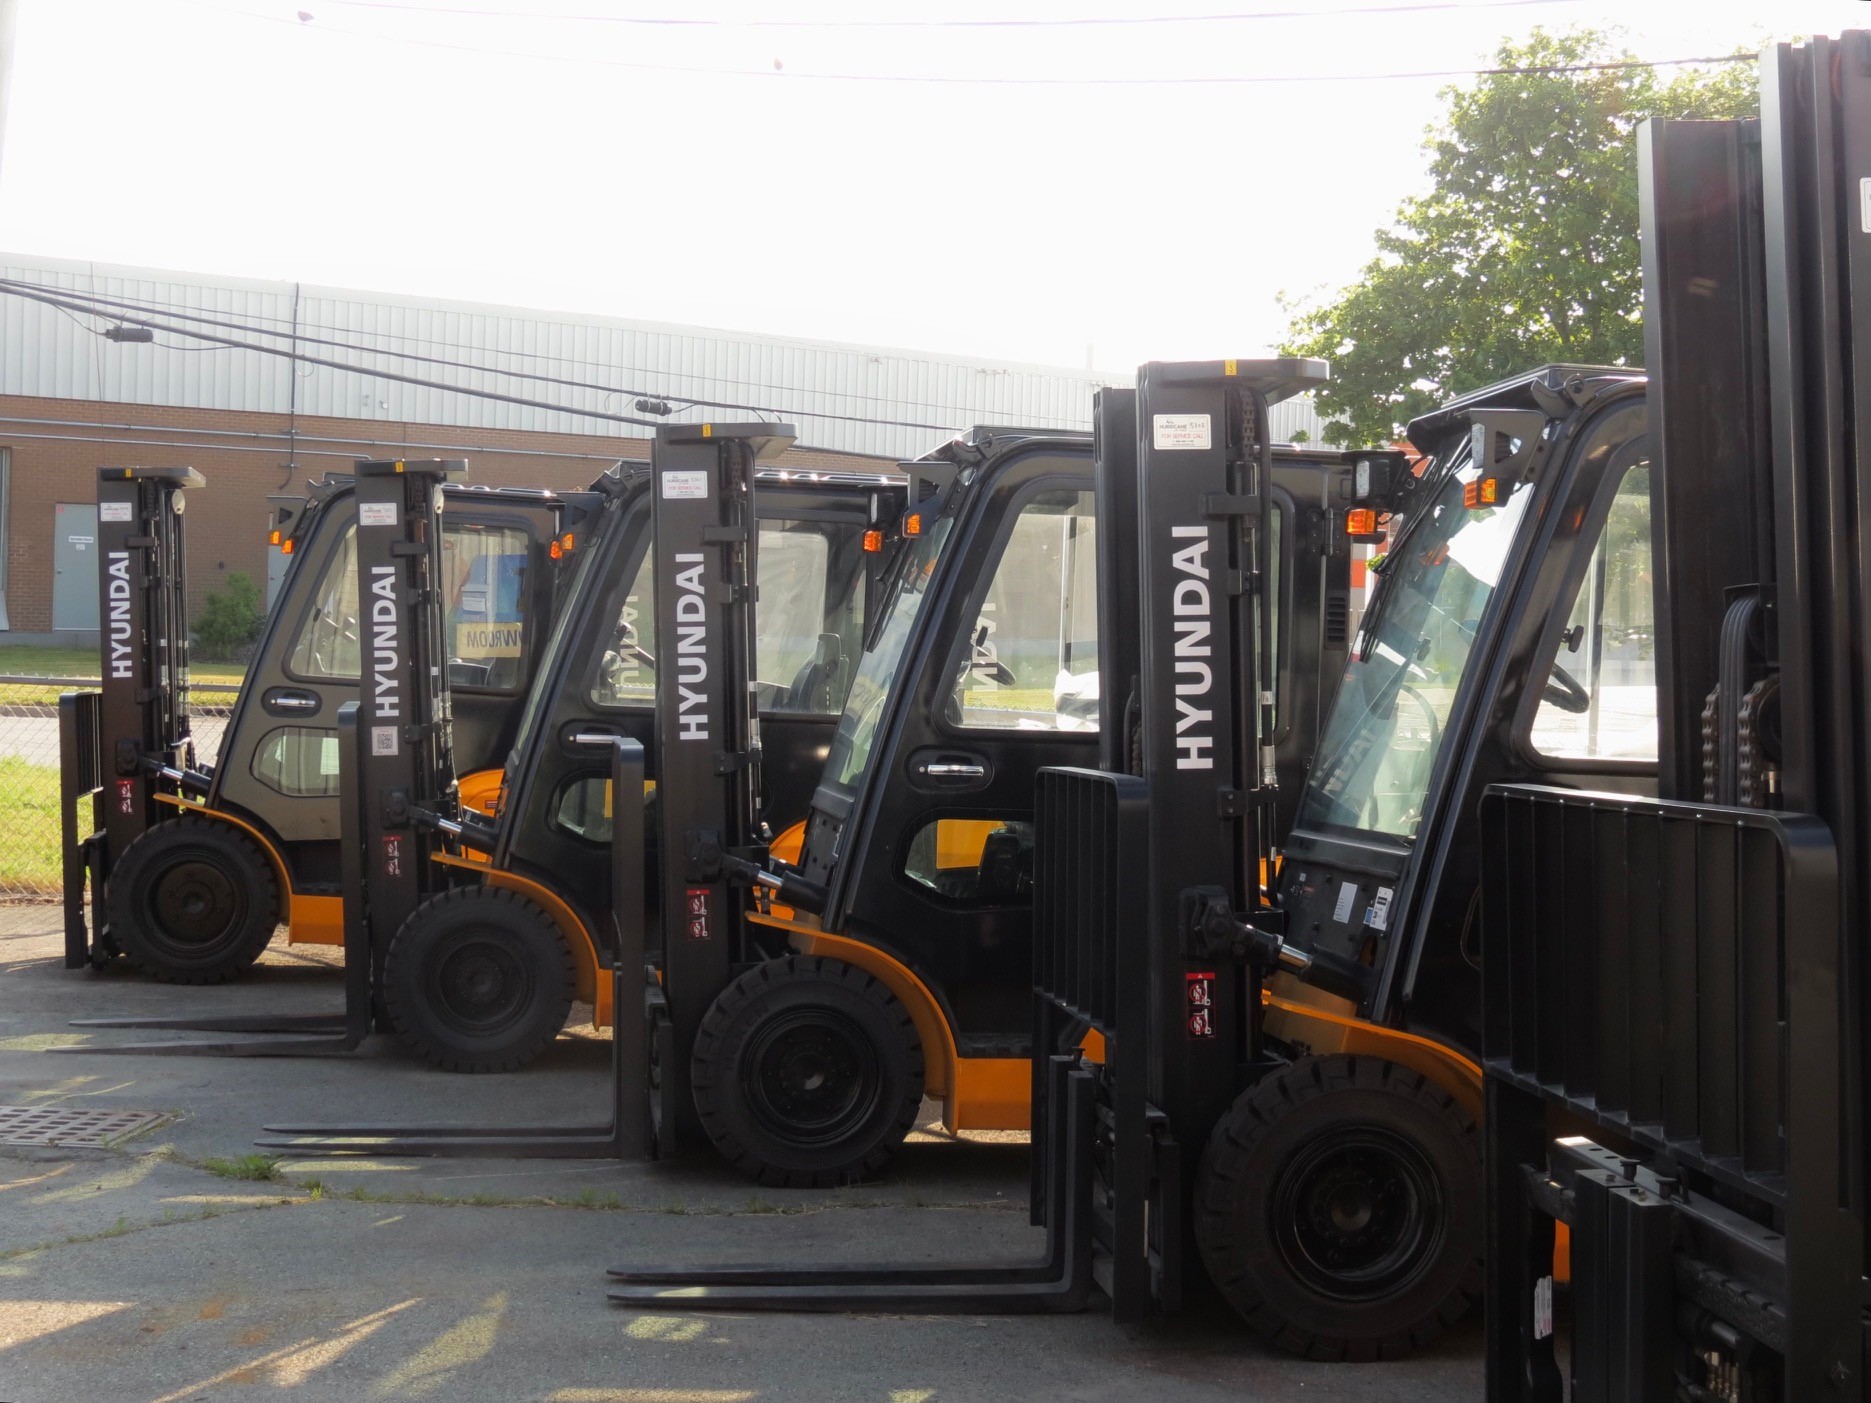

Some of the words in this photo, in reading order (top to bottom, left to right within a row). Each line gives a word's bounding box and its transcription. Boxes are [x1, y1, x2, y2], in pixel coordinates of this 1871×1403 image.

[109, 551, 133, 678] HYUNDAI
[371, 566, 400, 718] HYUNDAI
[674, 552, 709, 742] HYUNDAI
[1172, 525, 1214, 770] HYUNDAI
